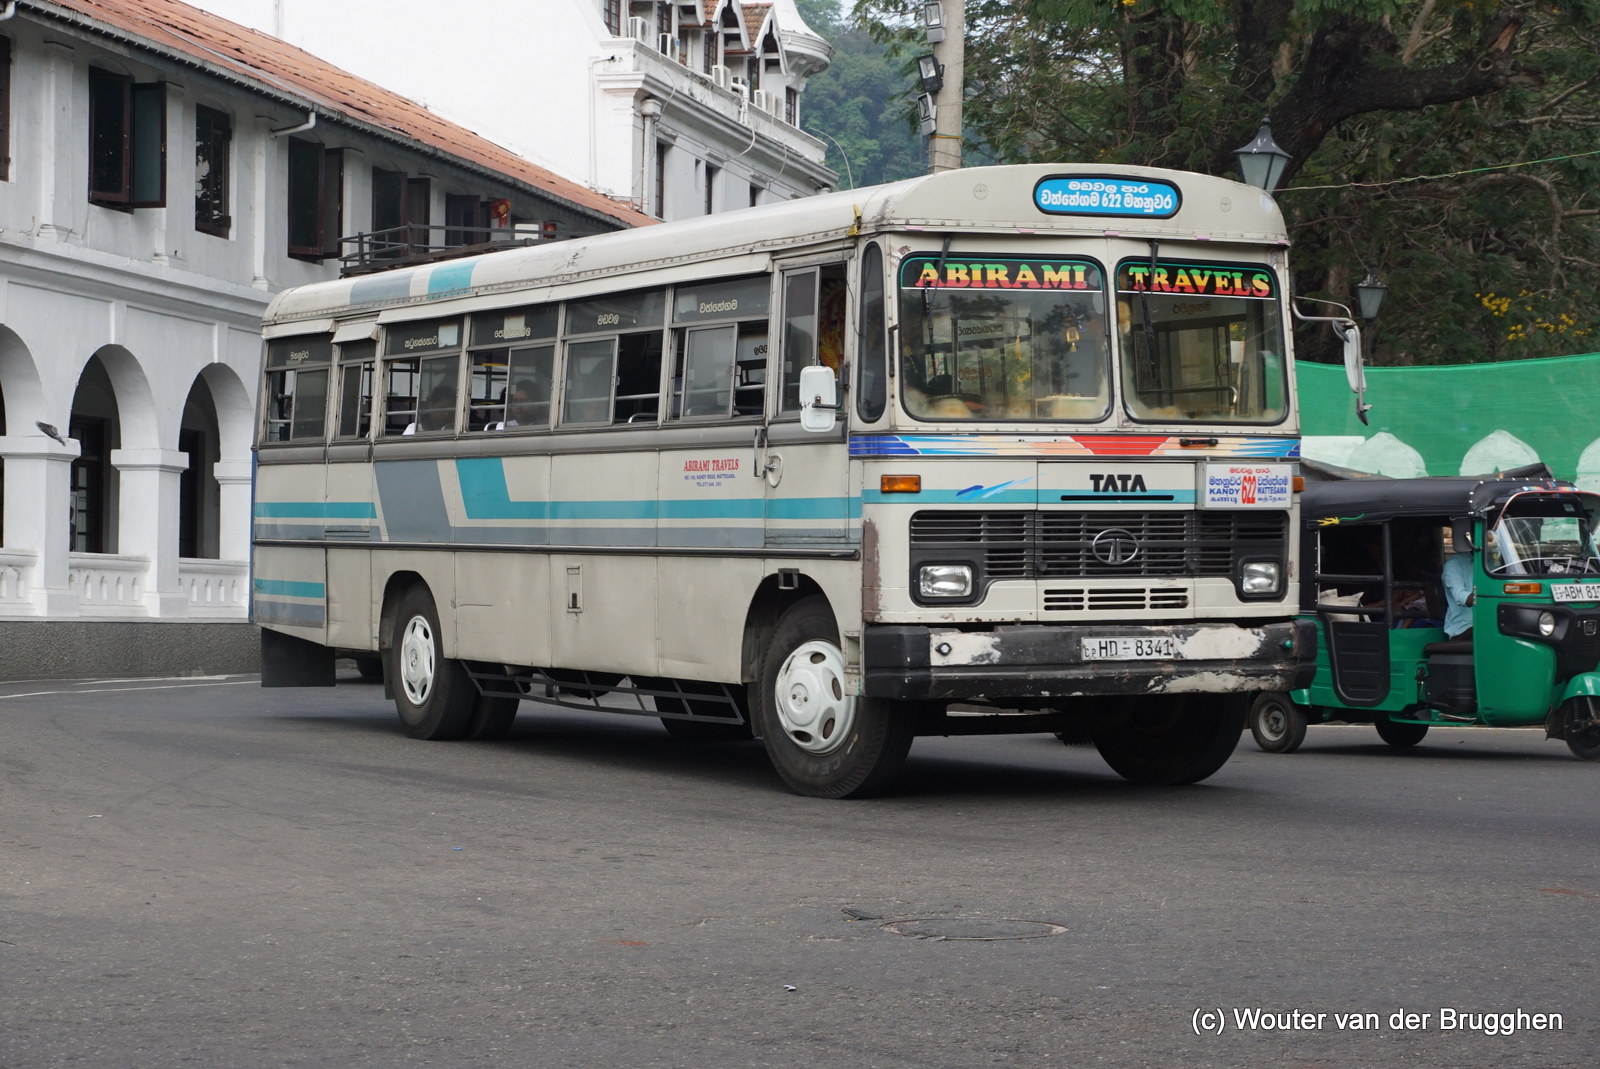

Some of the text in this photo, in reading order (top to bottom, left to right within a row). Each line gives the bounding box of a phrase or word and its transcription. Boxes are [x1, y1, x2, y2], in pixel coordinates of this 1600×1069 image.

[1068, 181, 1149, 194] මඩවල පාර
[1102, 193, 1122, 208] 622
[1124, 194, 1173, 212] මහනුවර
[915, 262, 1271, 297] ABIRAMI TRAVELS
[597, 313, 620, 326] මඩවල
[683, 458, 739, 471] ABIRAMI TRAVELS
[1089, 474, 1147, 492] TATA
[1241, 475, 1257, 504] 622
[1257, 487, 1287, 495] WATTEGAMA
[1565, 586, 1584, 599] ABM
